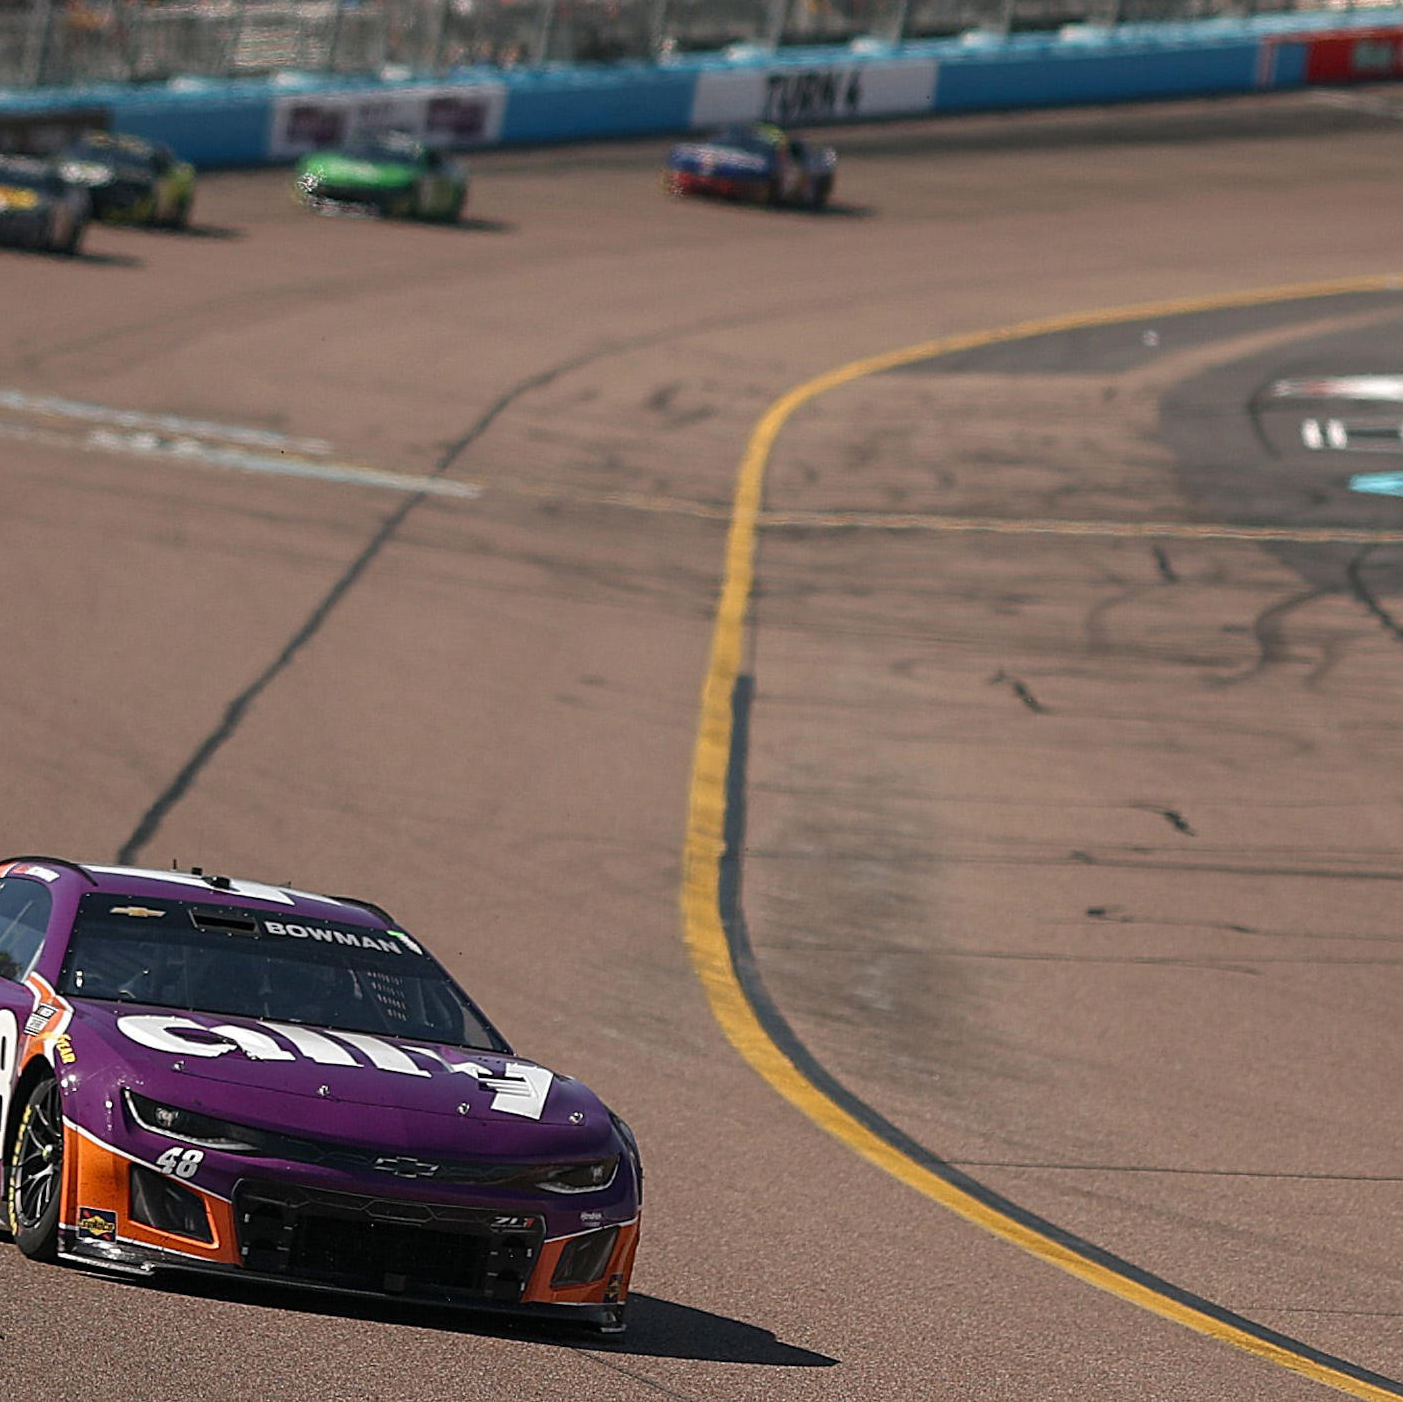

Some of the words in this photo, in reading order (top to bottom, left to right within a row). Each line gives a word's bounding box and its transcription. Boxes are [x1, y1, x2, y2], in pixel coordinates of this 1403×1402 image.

[764, 69, 834, 124] TURN
[844, 67, 863, 114] 4
[263, 920, 403, 955] BOWMAN
[116, 1013, 555, 1121] ally
[155, 1146, 205, 1179] 48
